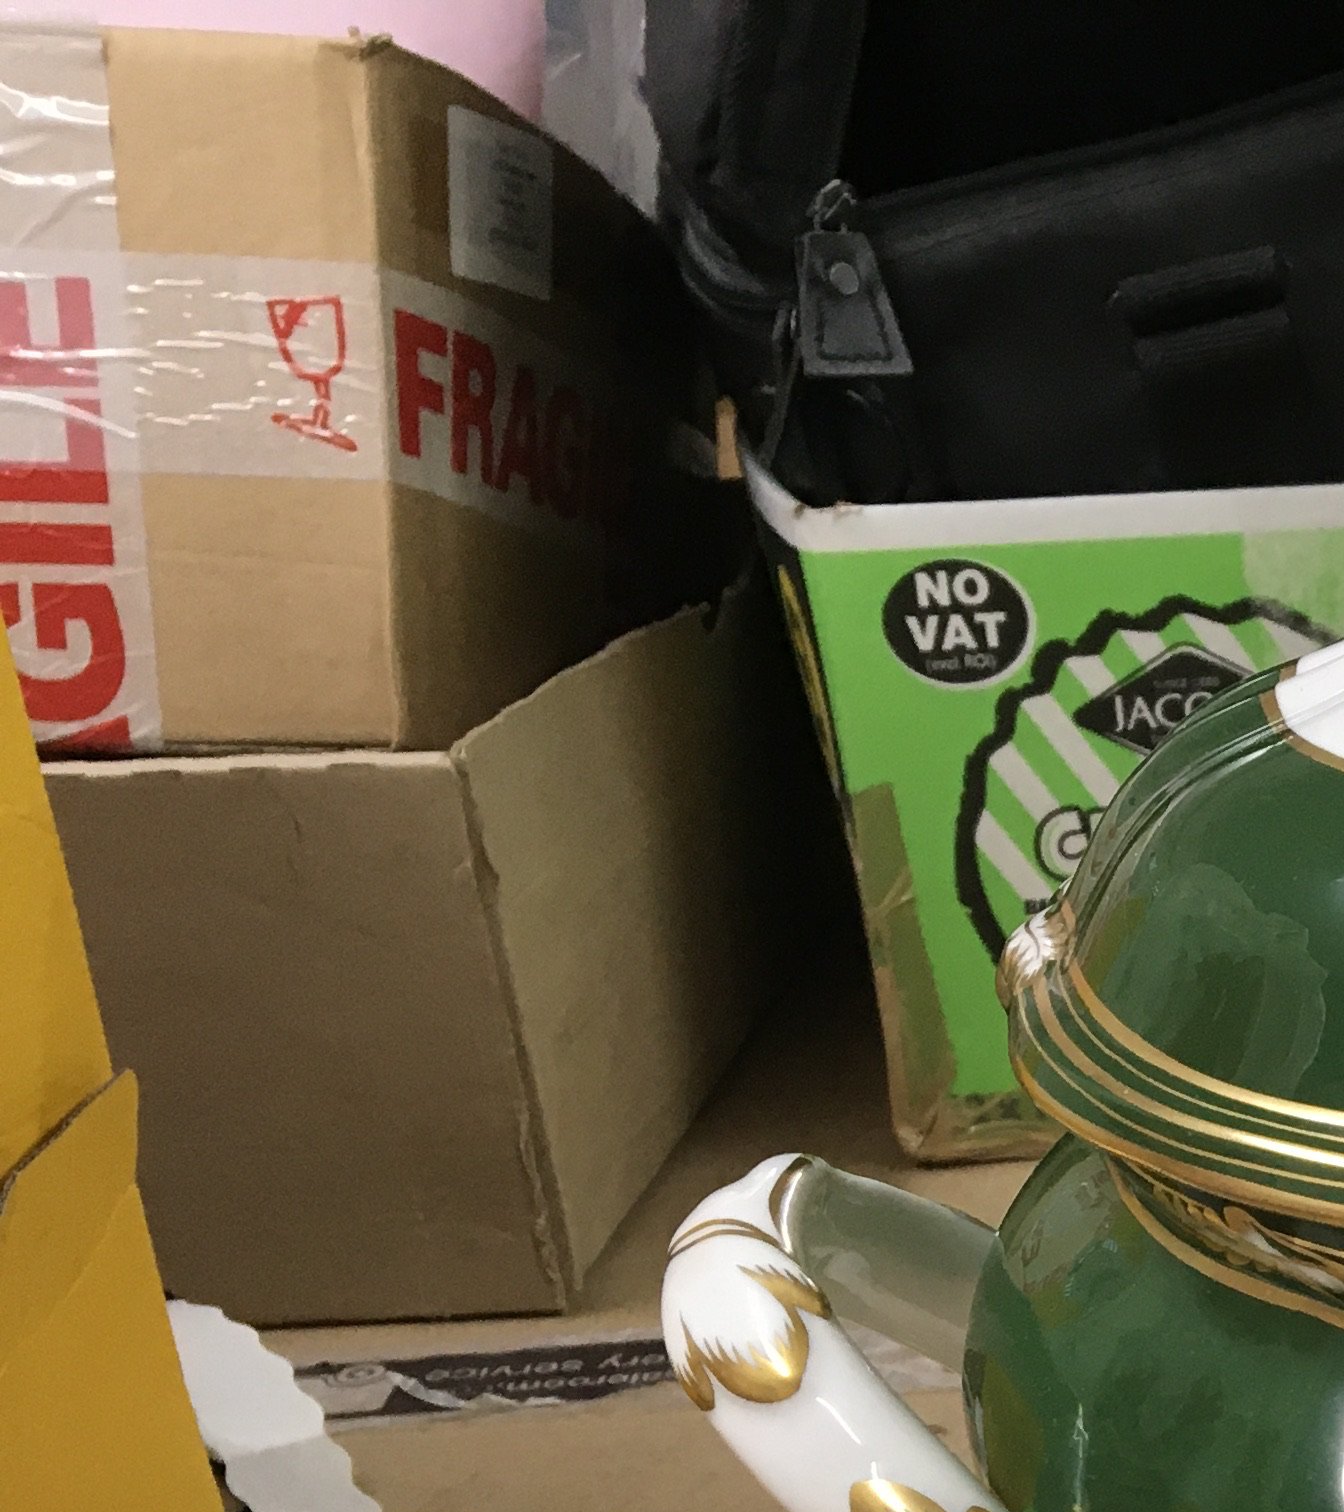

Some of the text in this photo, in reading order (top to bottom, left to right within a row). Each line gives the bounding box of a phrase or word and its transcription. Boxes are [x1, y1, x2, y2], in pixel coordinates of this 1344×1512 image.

[393, 308, 606, 521] FRAG
[0, 276, 132, 747] GILE
[904, 611, 1007, 653] VAT
[914, 568, 990, 608] NO
